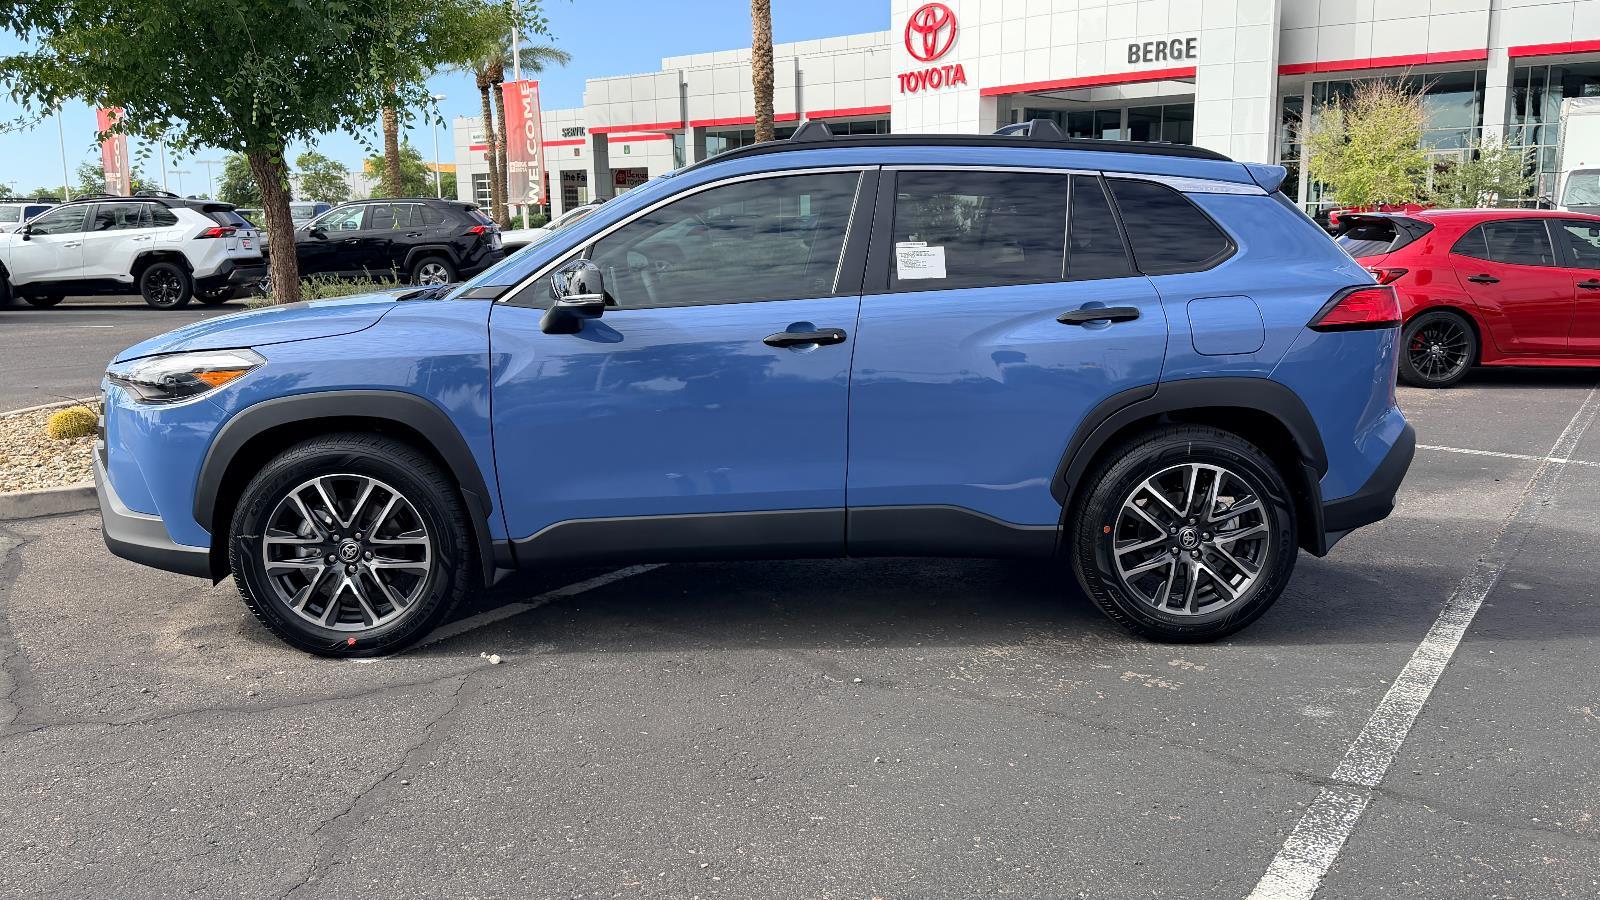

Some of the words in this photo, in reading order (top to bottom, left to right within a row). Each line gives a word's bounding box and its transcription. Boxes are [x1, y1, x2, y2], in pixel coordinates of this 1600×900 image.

[1127, 37, 1197, 64] BERGE
[897, 63, 967, 94] TOYOTA
[520, 82, 540, 204] WELCOME
